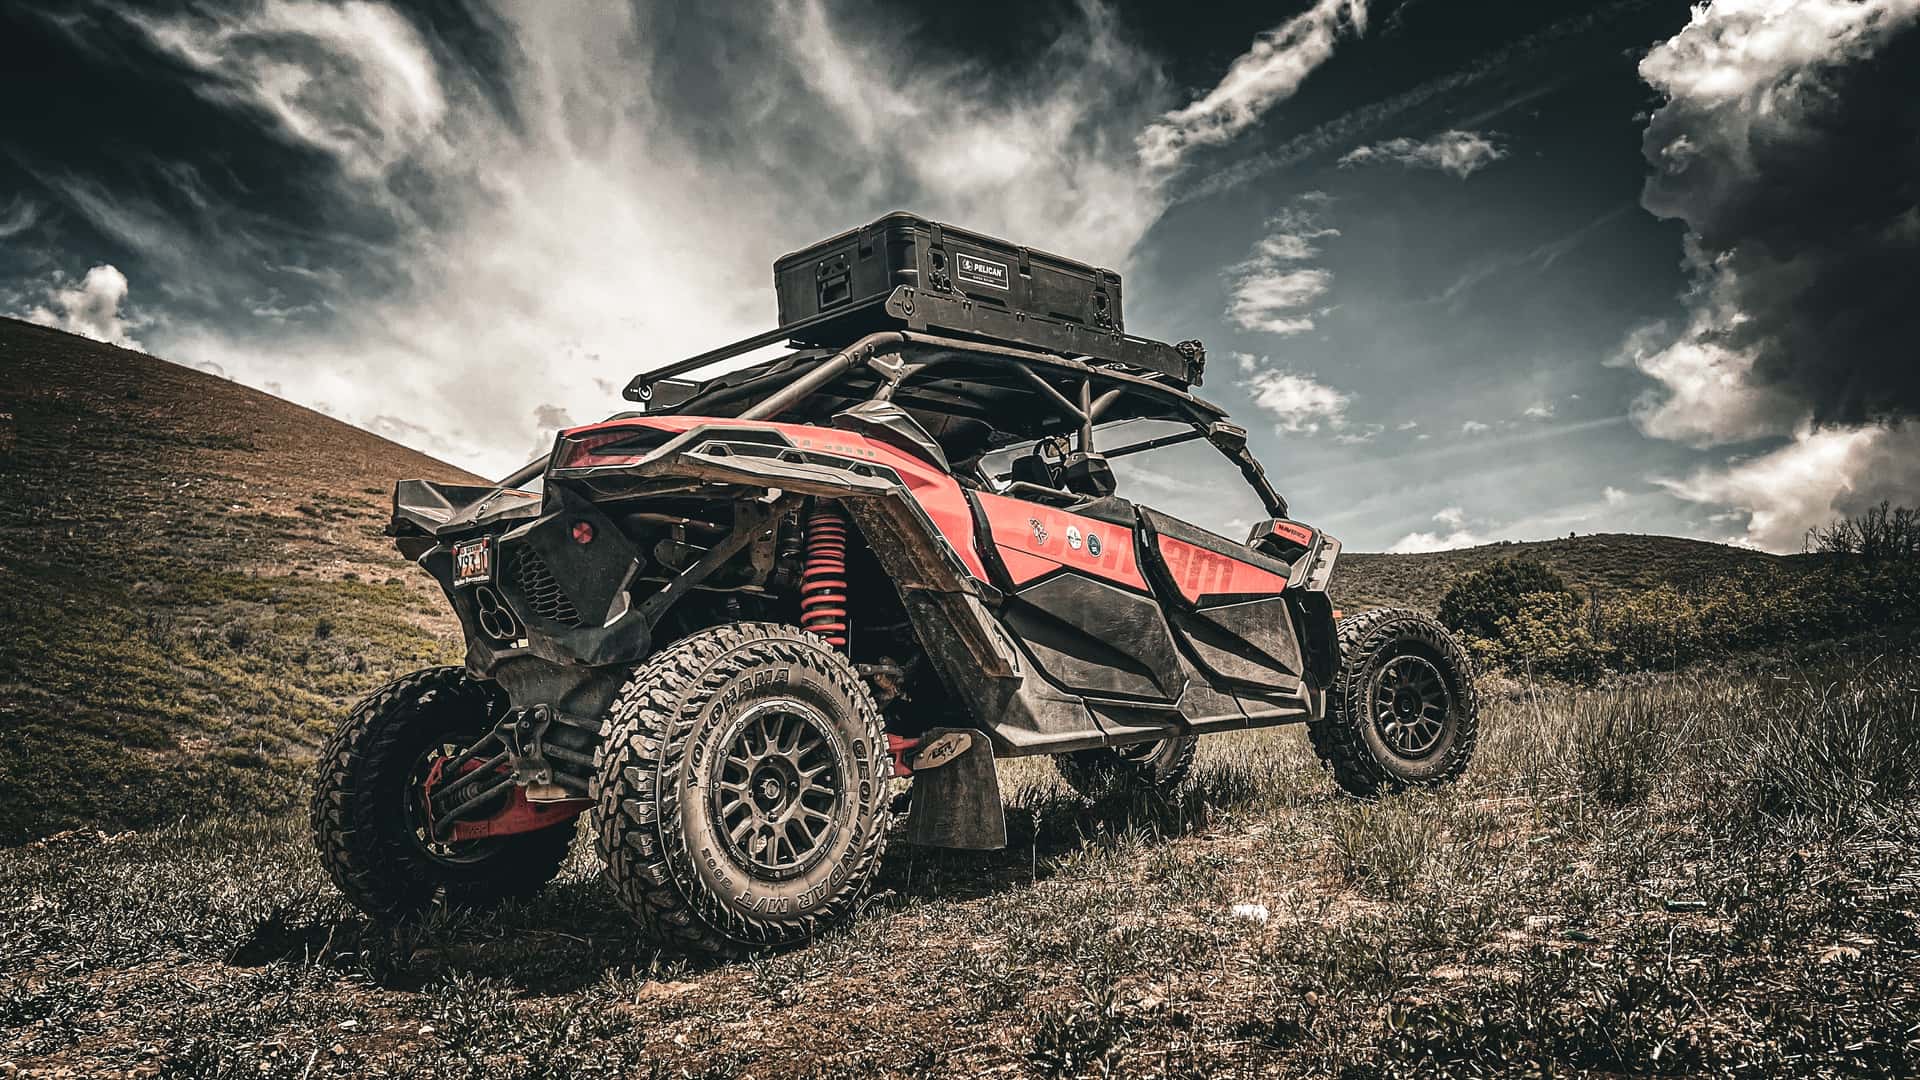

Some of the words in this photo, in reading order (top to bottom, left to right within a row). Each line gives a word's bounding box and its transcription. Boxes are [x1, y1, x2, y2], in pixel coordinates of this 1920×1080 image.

[974, 263, 1003, 277] PELICAN
[686, 668, 790, 789] YOKOHAMA
[798, 738, 871, 909] GEOLANDAR
